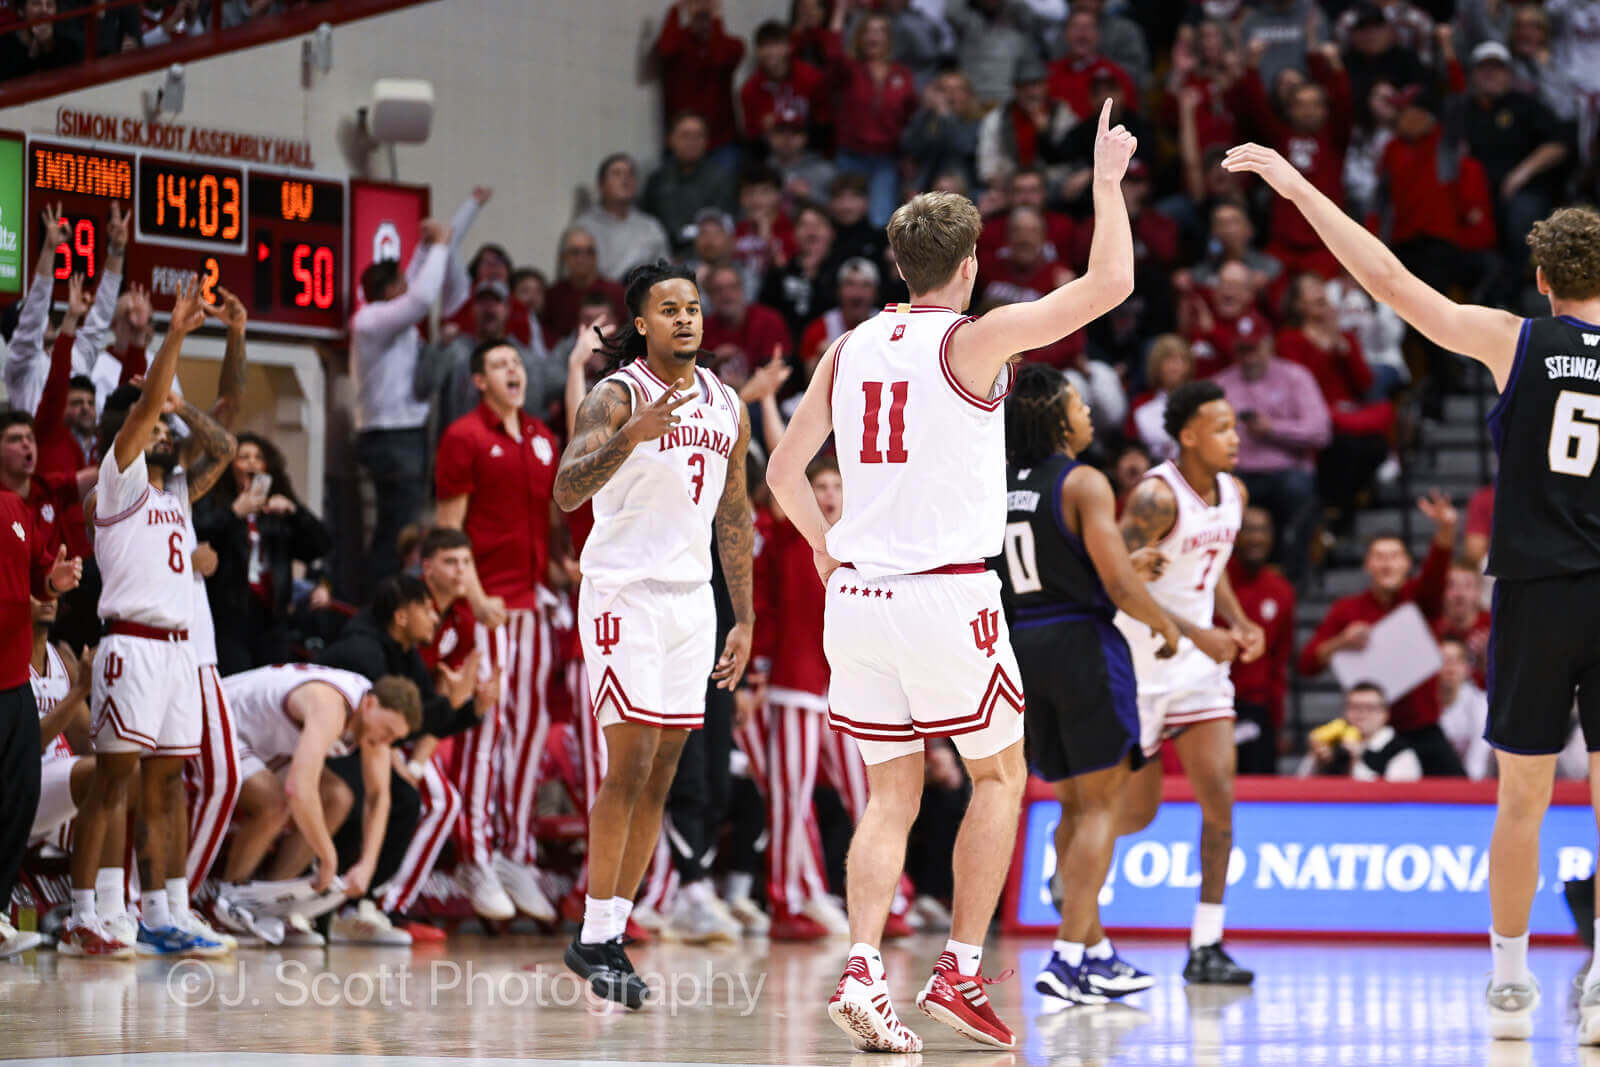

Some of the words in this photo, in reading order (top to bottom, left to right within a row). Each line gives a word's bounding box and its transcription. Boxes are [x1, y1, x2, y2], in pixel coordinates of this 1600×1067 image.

[61, 109, 117, 142] SIMON
[189, 127, 273, 162] ASSEMBLY
[274, 139, 314, 168] HALL
[35, 150, 131, 199] INDIANA
[156, 173, 240, 241] 14:03
[203, 257, 219, 305] 2
[293, 244, 334, 309] 50
[659, 425, 731, 459] INDIANA
[860, 381, 909, 463] 11
[1548, 389, 1600, 478] 6
[687, 452, 705, 505] 3
[168, 531, 184, 573] 6
[1005, 520, 1043, 594] 0
[1194, 548, 1219, 592] 7
[1254, 842, 1545, 893] NATION
